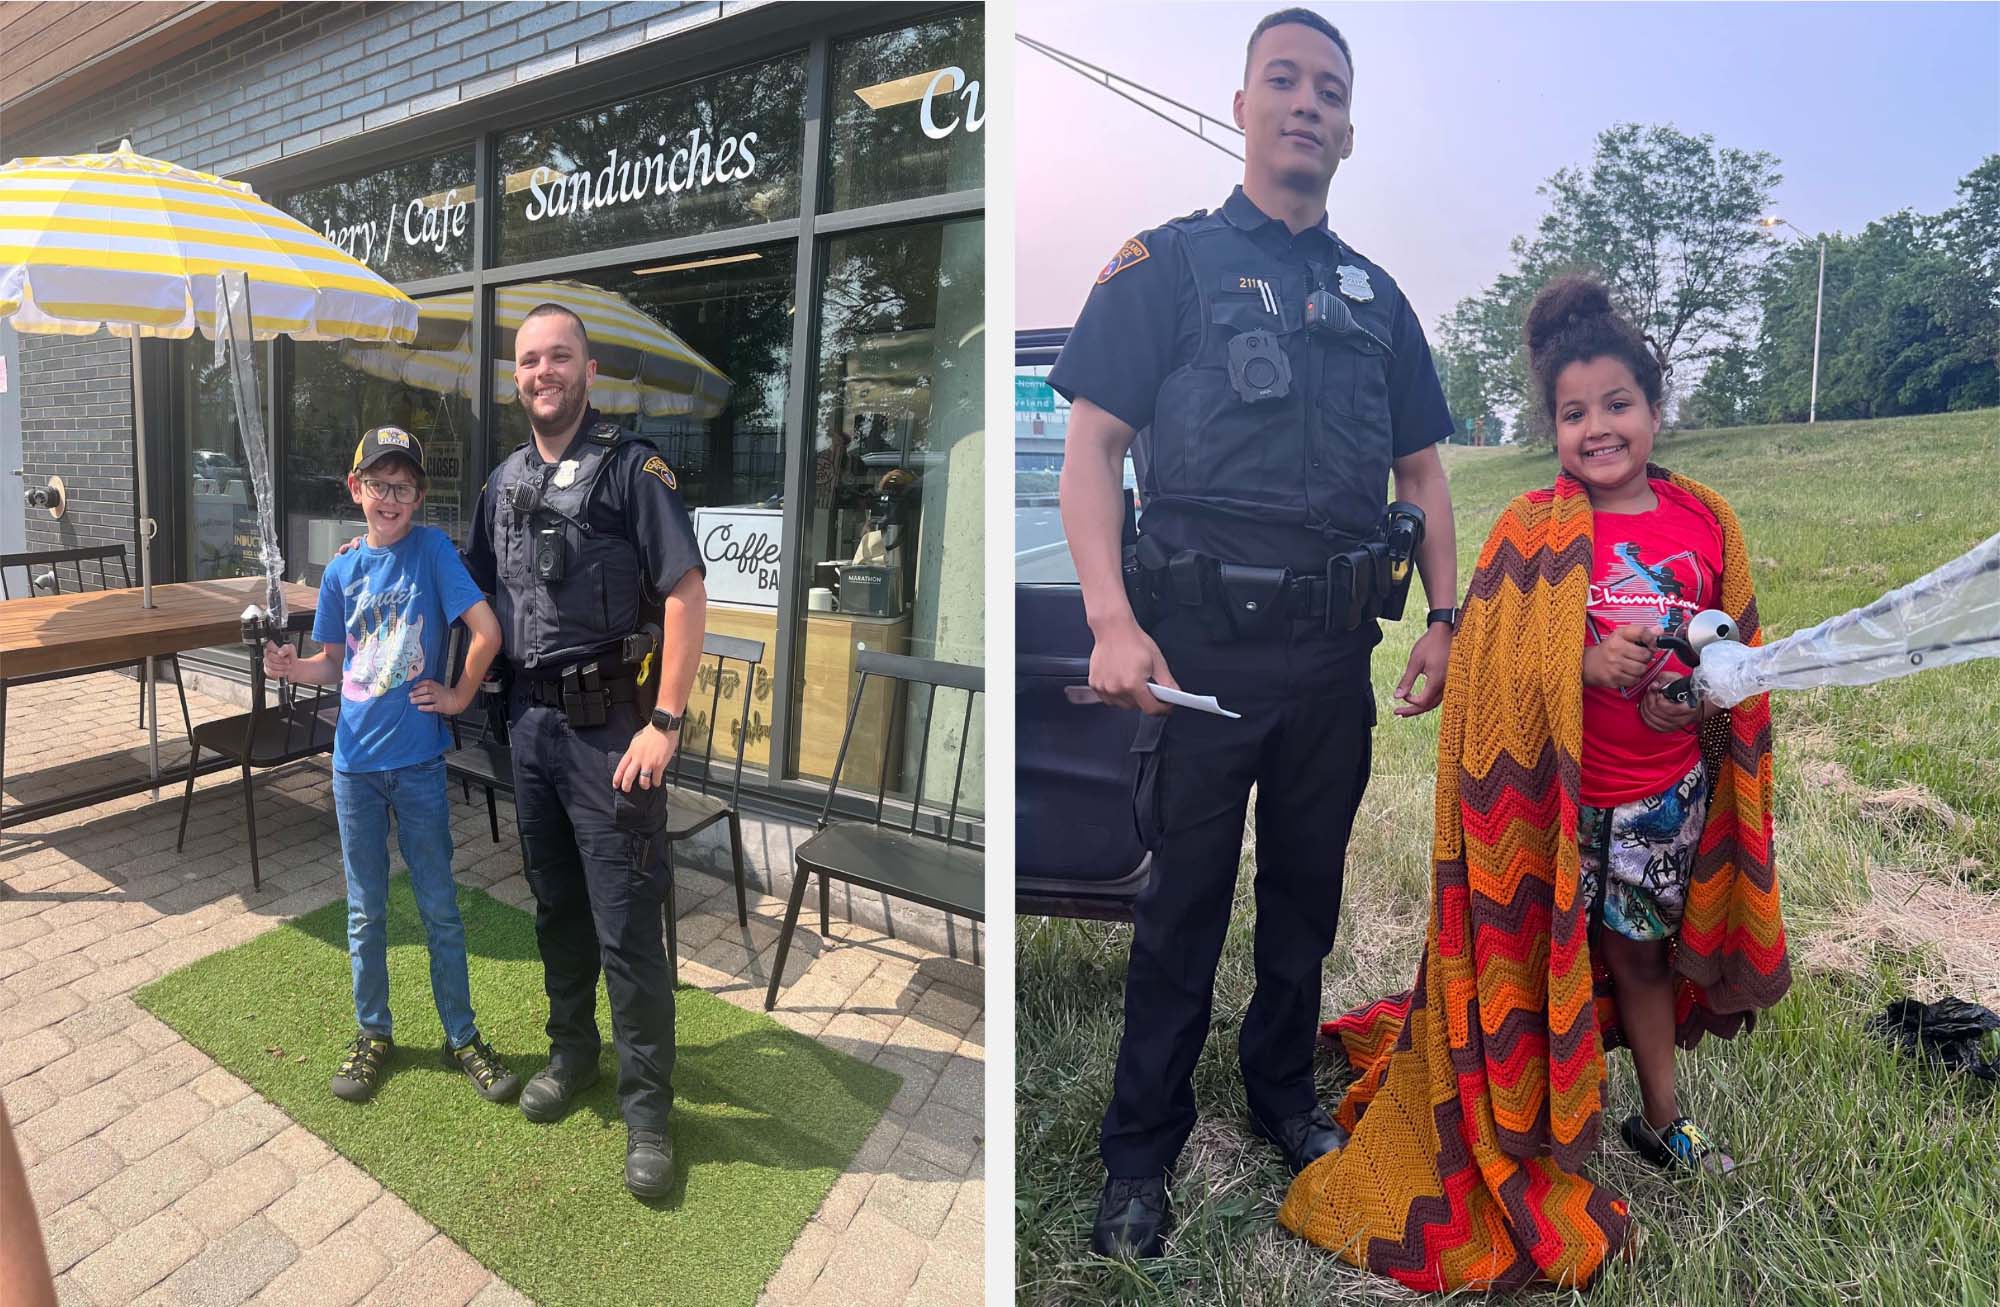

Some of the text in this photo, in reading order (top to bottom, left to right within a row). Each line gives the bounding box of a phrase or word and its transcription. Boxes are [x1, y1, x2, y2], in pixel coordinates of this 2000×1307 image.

[525, 127, 758, 221] Sandwiches
[403, 189, 467, 253] Cafe
[426, 456, 460, 478] CLOSED
[344, 568, 422, 628] Fender
[848, 575, 882, 583] MARATHON
[1586, 584, 1700, 615] Champion
